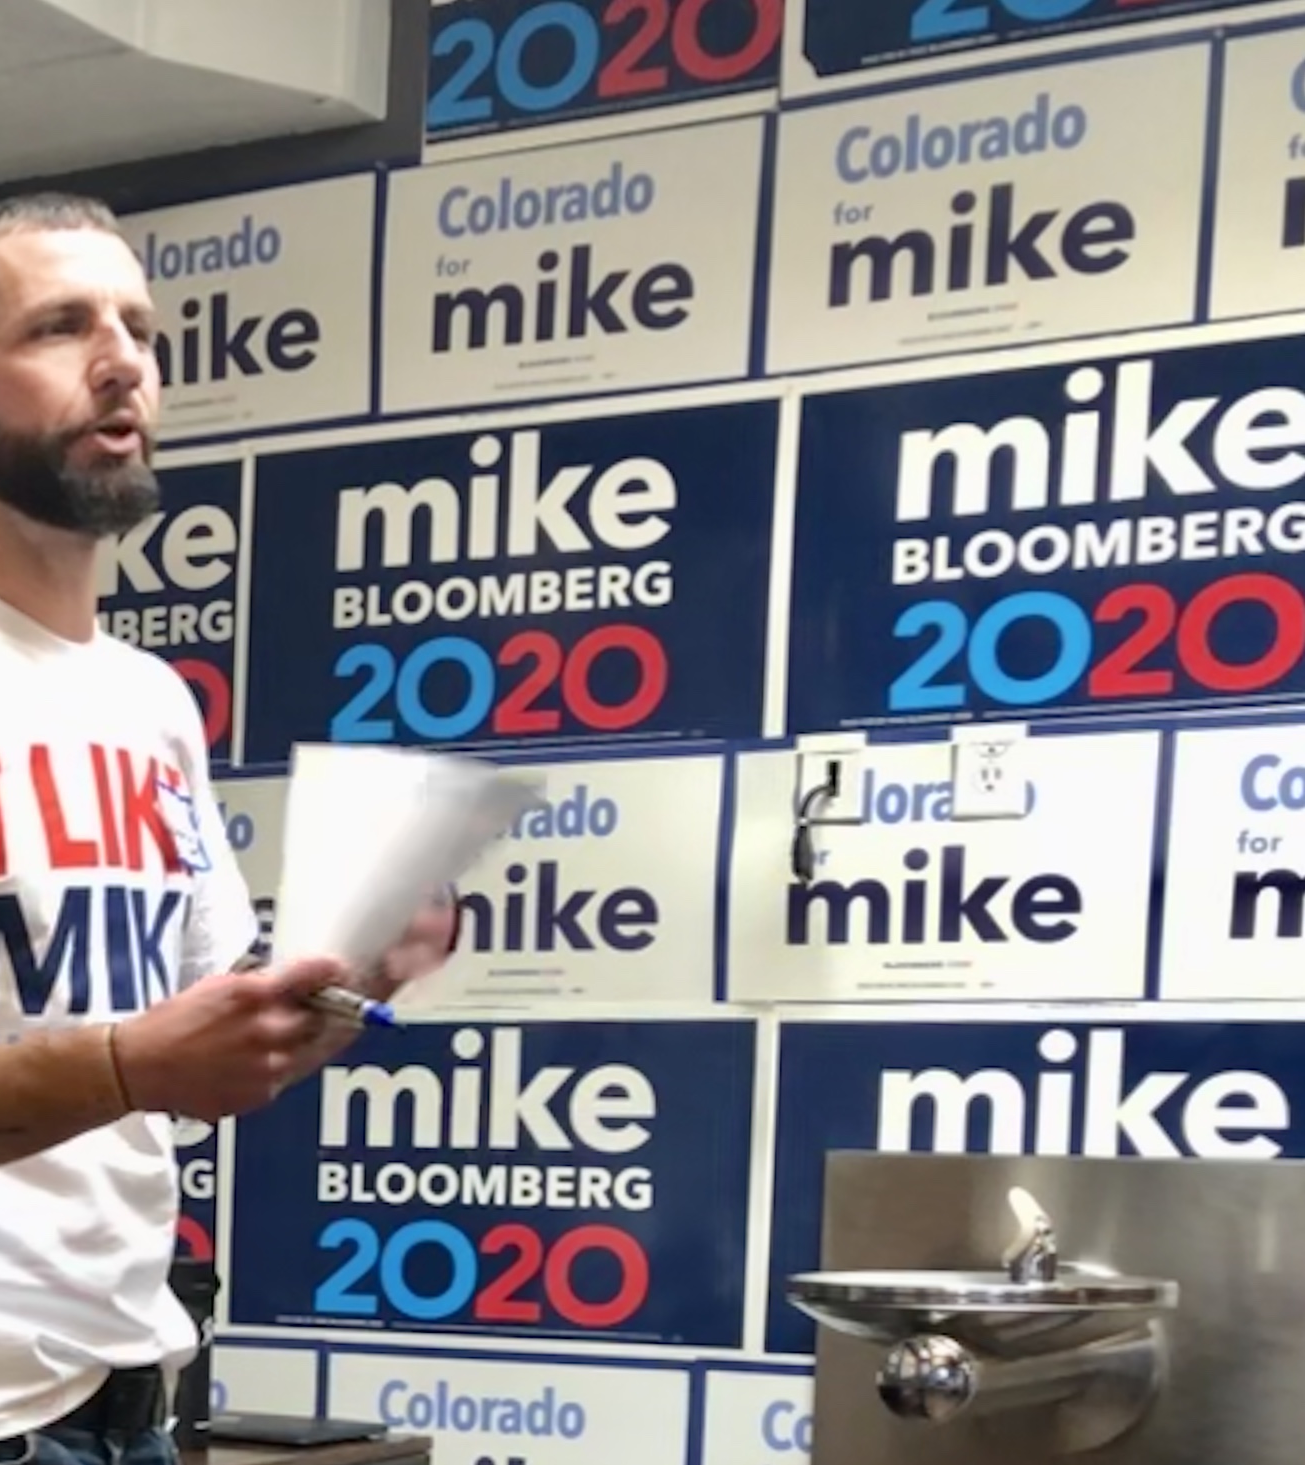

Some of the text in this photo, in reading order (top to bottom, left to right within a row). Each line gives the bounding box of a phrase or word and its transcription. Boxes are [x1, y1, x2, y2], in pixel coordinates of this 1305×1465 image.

[426, 0, 783, 127] 2020
[835, 92, 1087, 184] Colorado
[146, 213, 281, 282] lorado
[436, 161, 655, 238] Colorado
[828, 182, 1136, 308] mike
[833, 201, 874, 226] for
[431, 244, 695, 354] mike
[435, 255, 470, 278] for
[895, 359, 1305, 522] mike
[335, 430, 677, 573] mike
[892, 501, 1305, 585] BLOOMBERG
[95, 504, 237, 599] ke
[332, 561, 674, 629] BLOOMBERG
[330, 624, 668, 743] 2020
[888, 572, 1305, 711] 2020
[1236, 830, 1283, 855] for
[785, 844, 1082, 945] mike
[319, 1026, 657, 1153] mike
[877, 1028, 1290, 1160] mike
[317, 1162, 652, 1211] BLOOMBERG
[314, 1217, 650, 1328] 2020
[378, 1378, 586, 1439] Colorado
